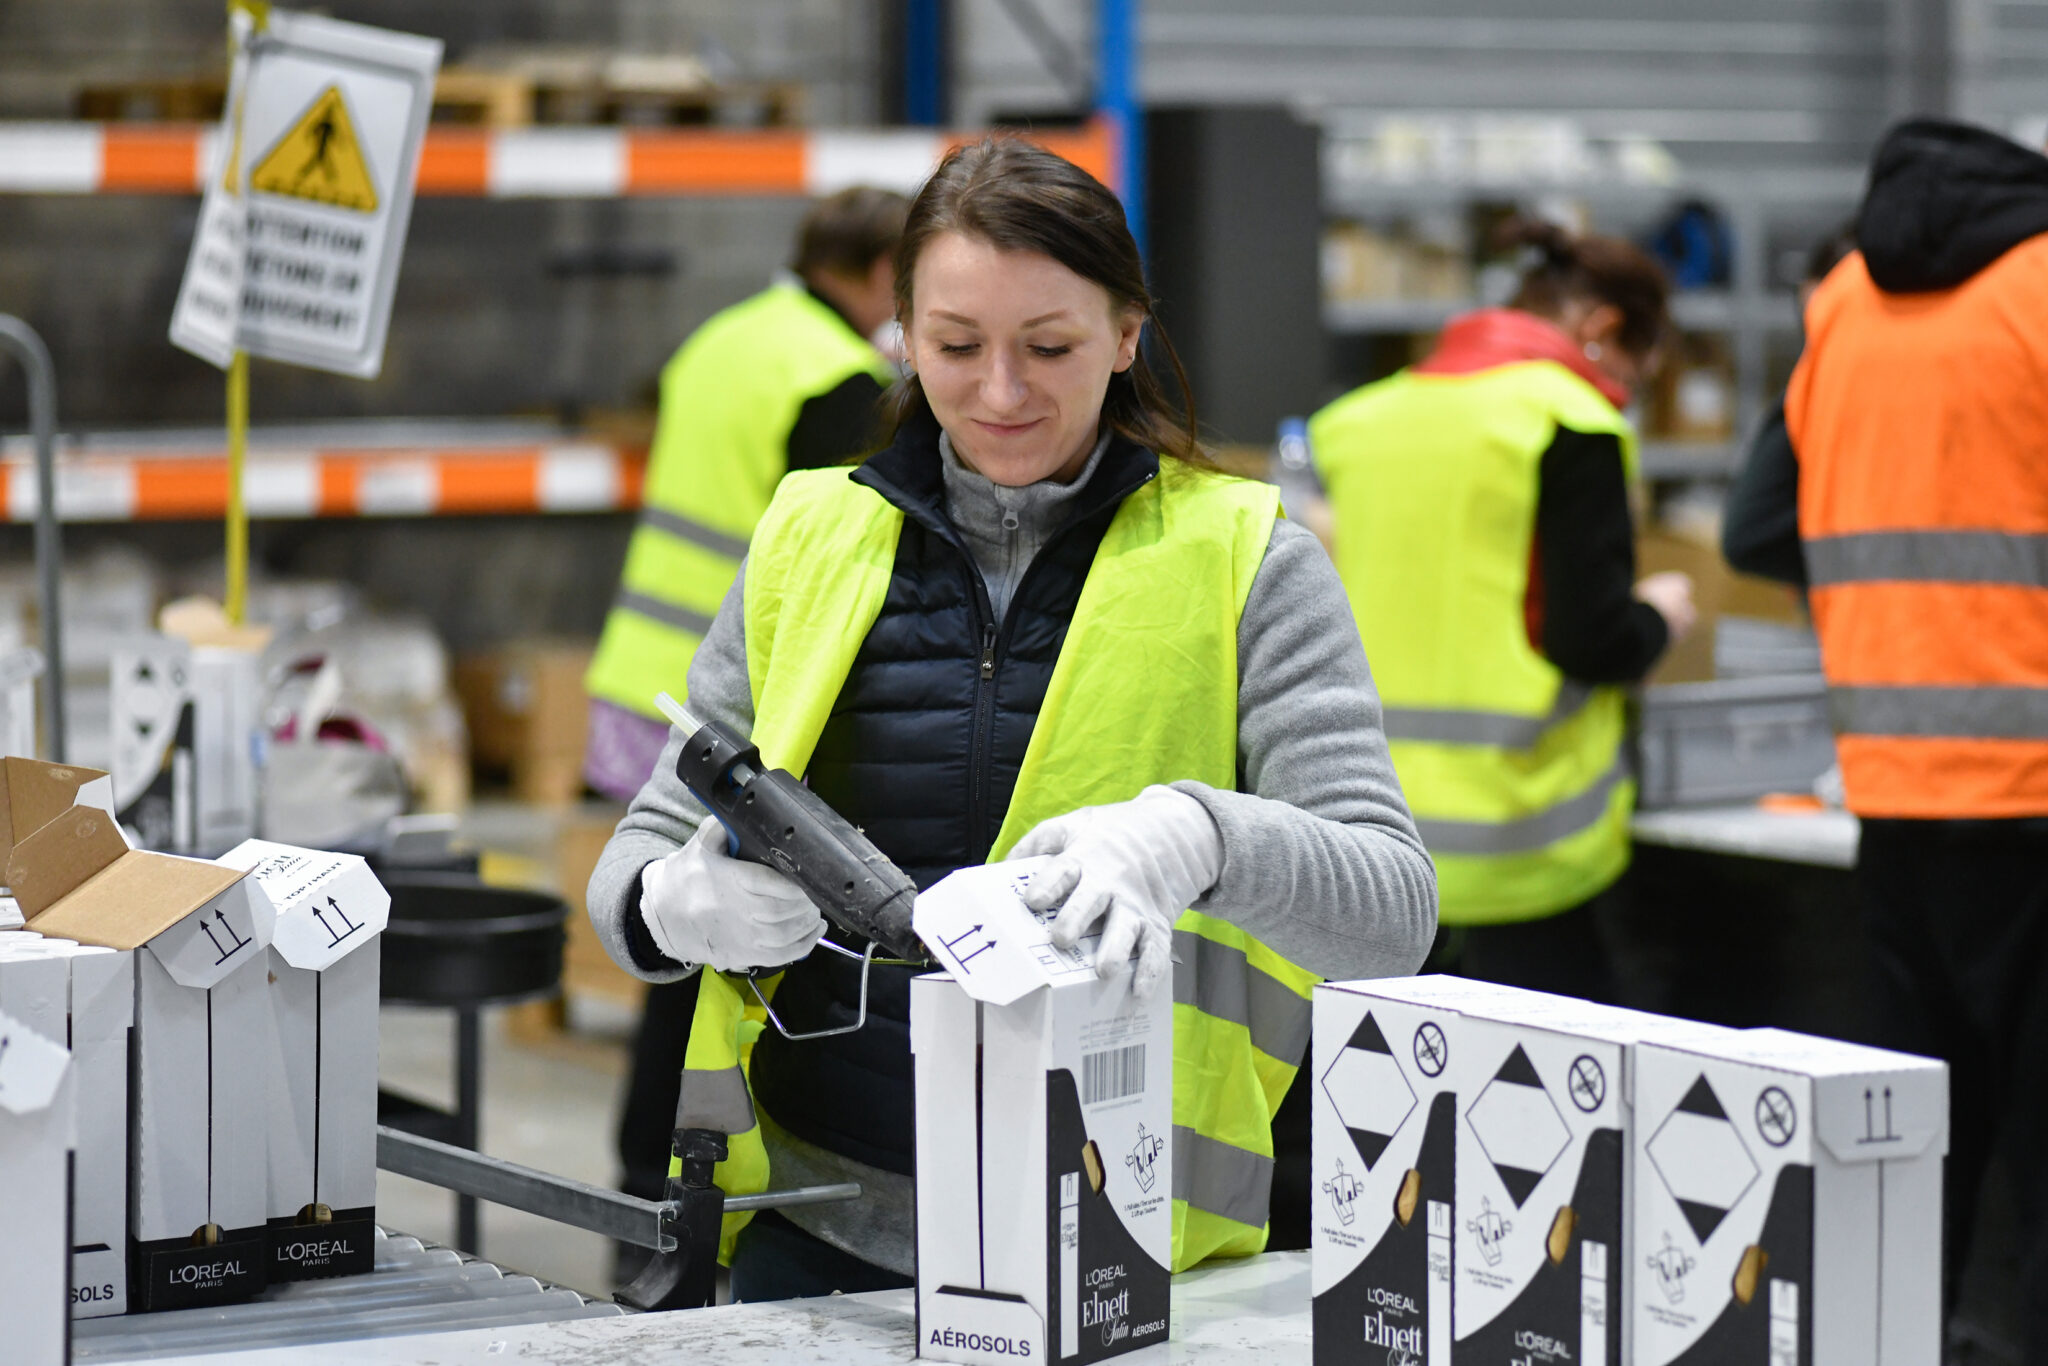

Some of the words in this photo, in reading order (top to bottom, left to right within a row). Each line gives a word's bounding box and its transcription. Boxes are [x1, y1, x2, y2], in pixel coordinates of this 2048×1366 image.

[311, 861, 343, 883] HAUT
[277, 1240, 354, 1261] L'ORÉAL
[302, 1256, 330, 1267] PARIS
[169, 1260, 247, 1284] L'ORÉAL
[195, 1279, 224, 1289] PARIS
[1082, 1287, 1130, 1328] Elnett
[1367, 1287, 1419, 1314] L'ORÉAL
[1132, 1319, 1165, 1338] AÉROSOLS
[1363, 1310, 1423, 1356] Elnett
[930, 1326, 1031, 1356] AÉROSOLS
